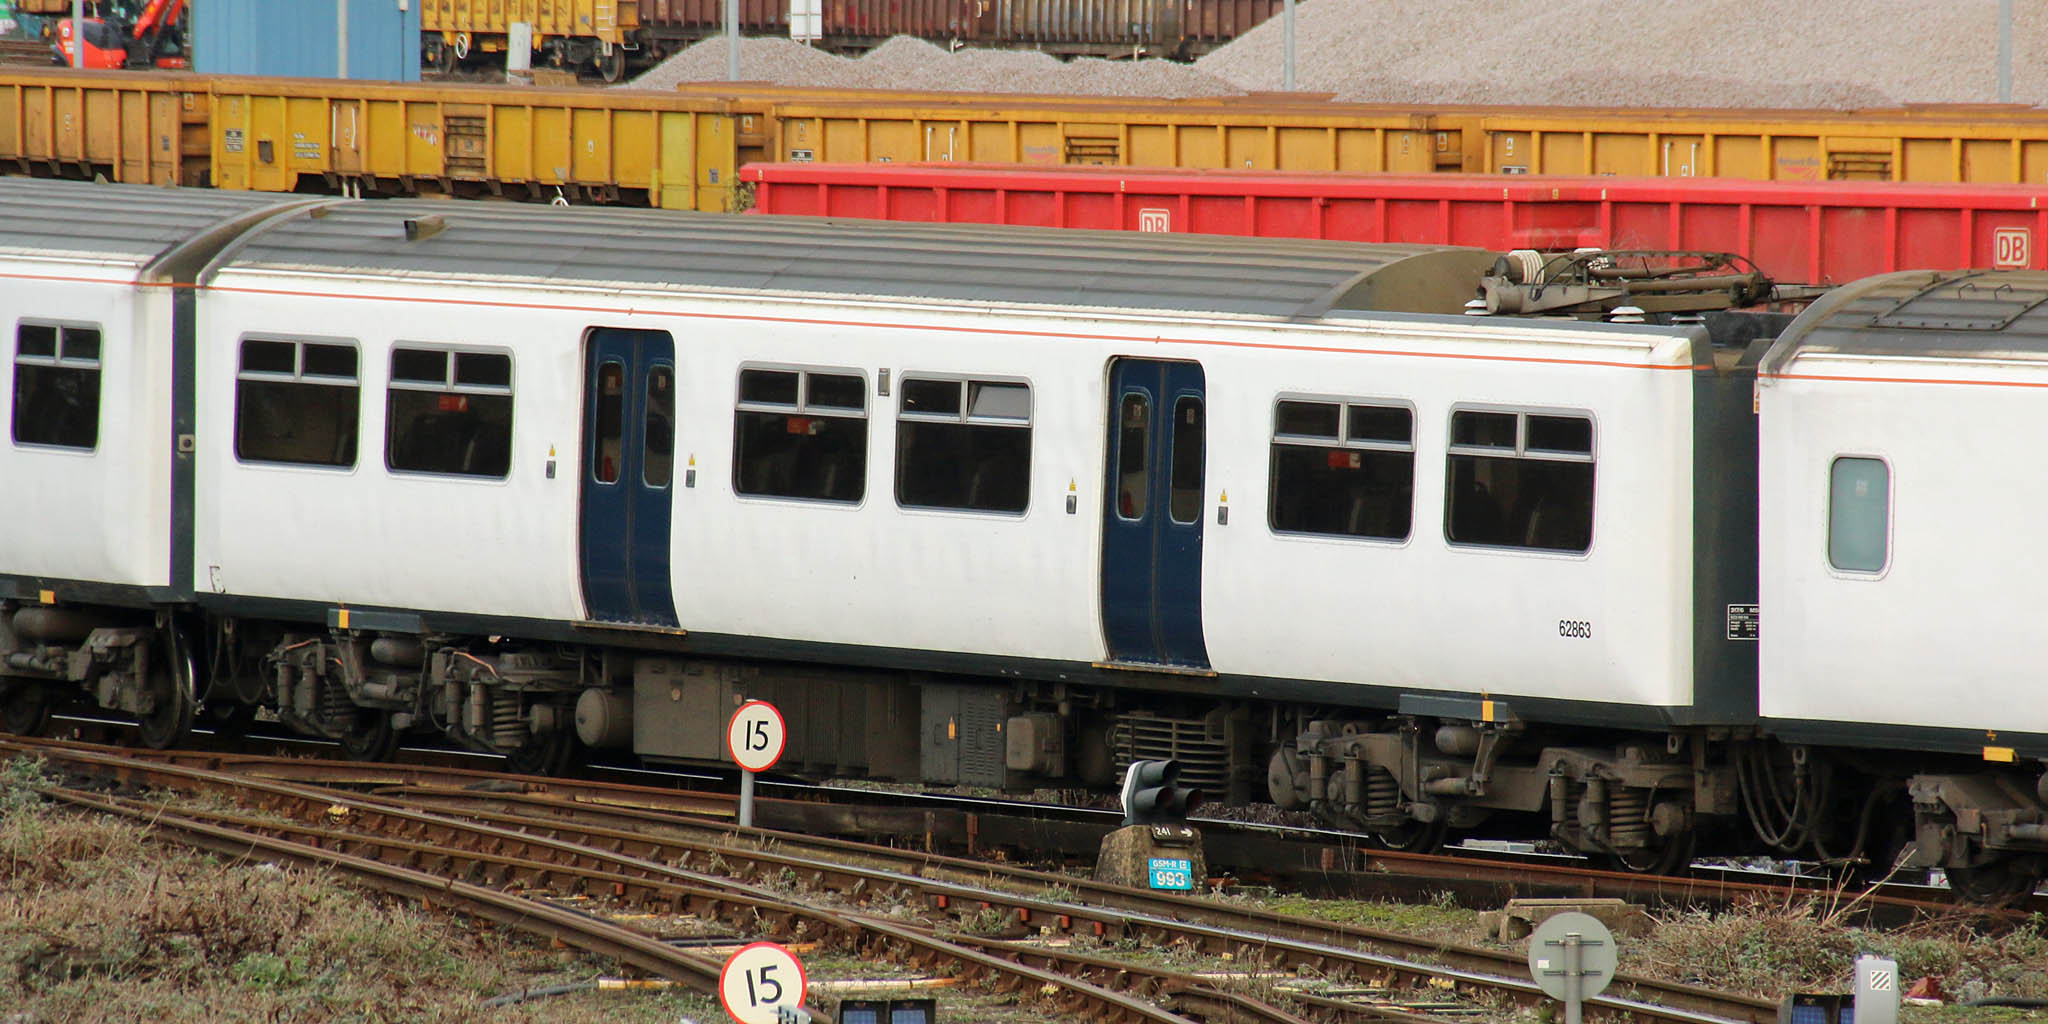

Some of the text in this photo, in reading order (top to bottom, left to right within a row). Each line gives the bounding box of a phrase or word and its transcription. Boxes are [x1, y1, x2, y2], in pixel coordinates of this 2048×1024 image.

[2000, 236, 2025, 262] DB
[1559, 619, 1592, 639] 62863
[745, 720, 769, 751] 15
[1155, 827, 1171, 836] 241
[1153, 860, 1177, 868] GSM-R
[1156, 871, 1185, 887] 993
[746, 965, 782, 1007] 15
